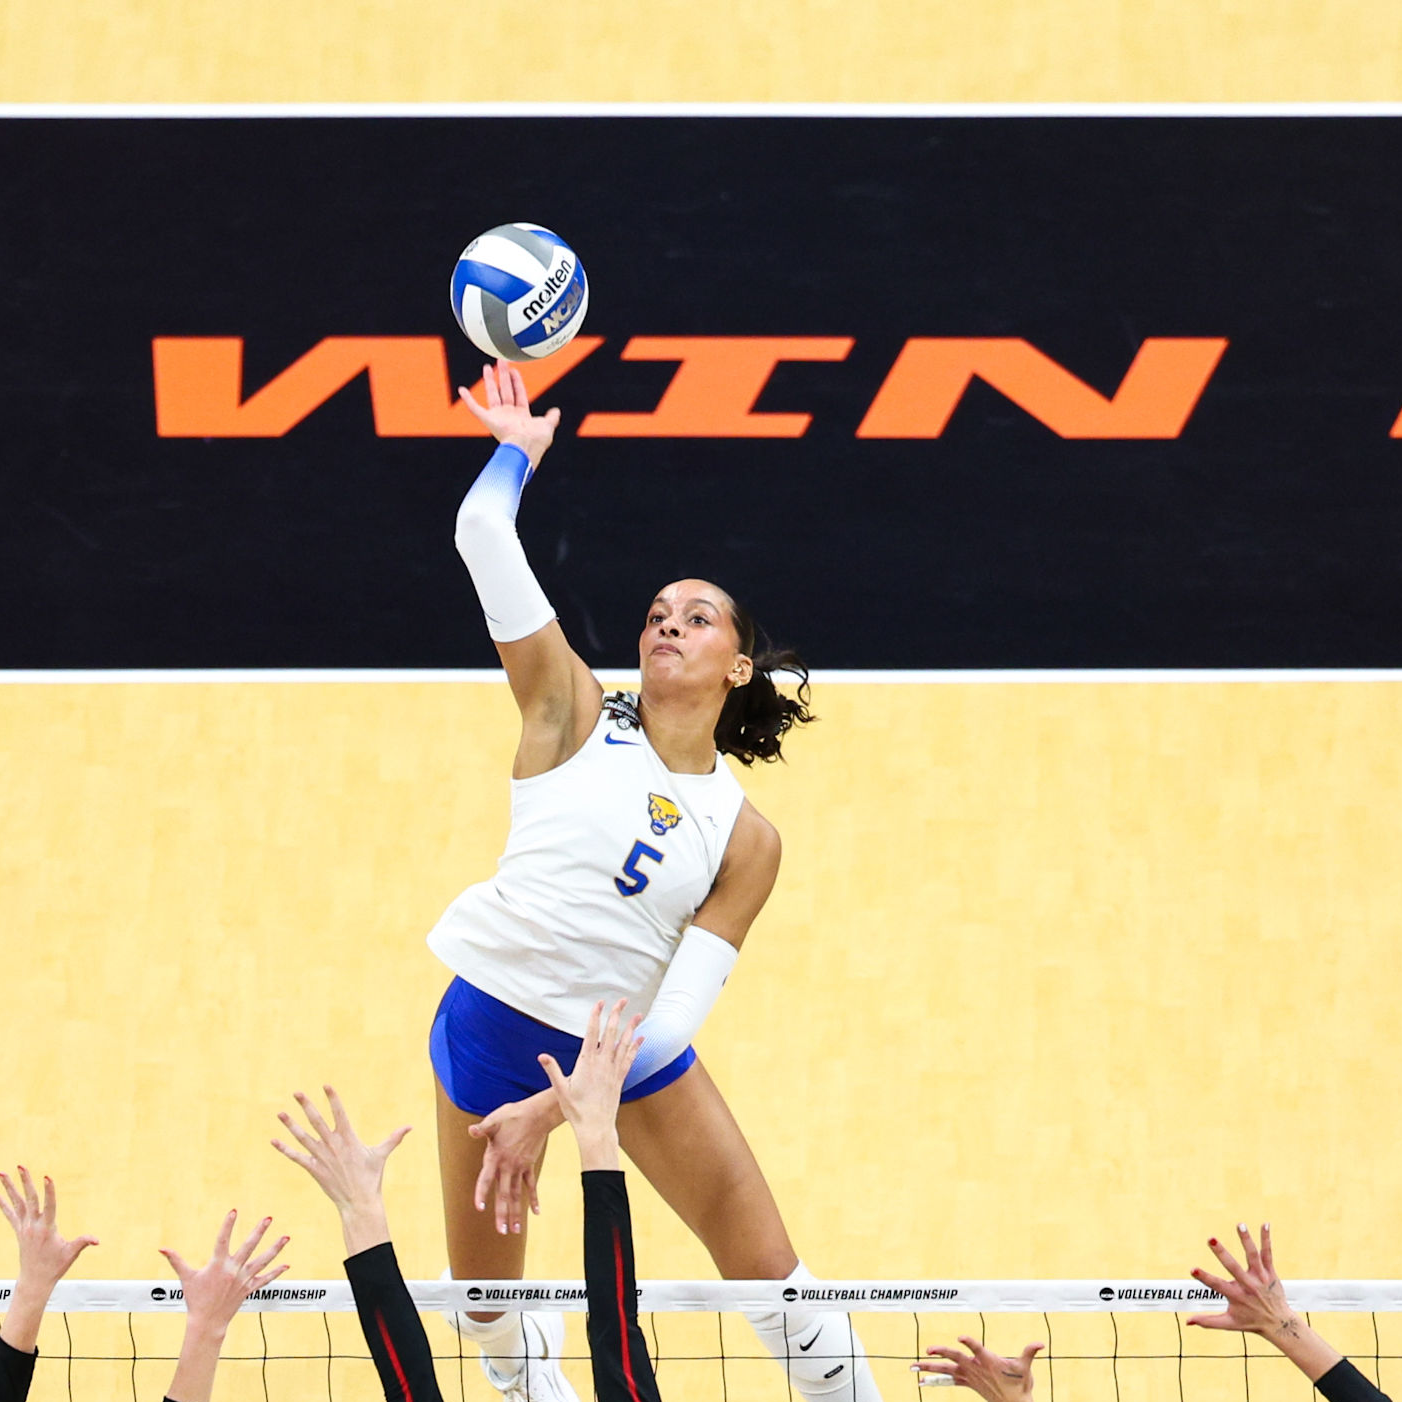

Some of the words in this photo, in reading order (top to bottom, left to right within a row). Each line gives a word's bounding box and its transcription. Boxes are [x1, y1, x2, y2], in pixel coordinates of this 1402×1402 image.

[523, 260, 572, 322] molten
[542, 282, 583, 335] NCAA
[152, 337, 1228, 439] WIN
[614, 838, 665, 898] 5
[485, 1289, 551, 1300] VOLLEYBALL
[801, 1289, 866, 1300] VOLLEYBALL
[870, 1289, 958, 1300] CHAMPIONSHIP
[1118, 1289, 1183, 1300] VOLLEYBALL
